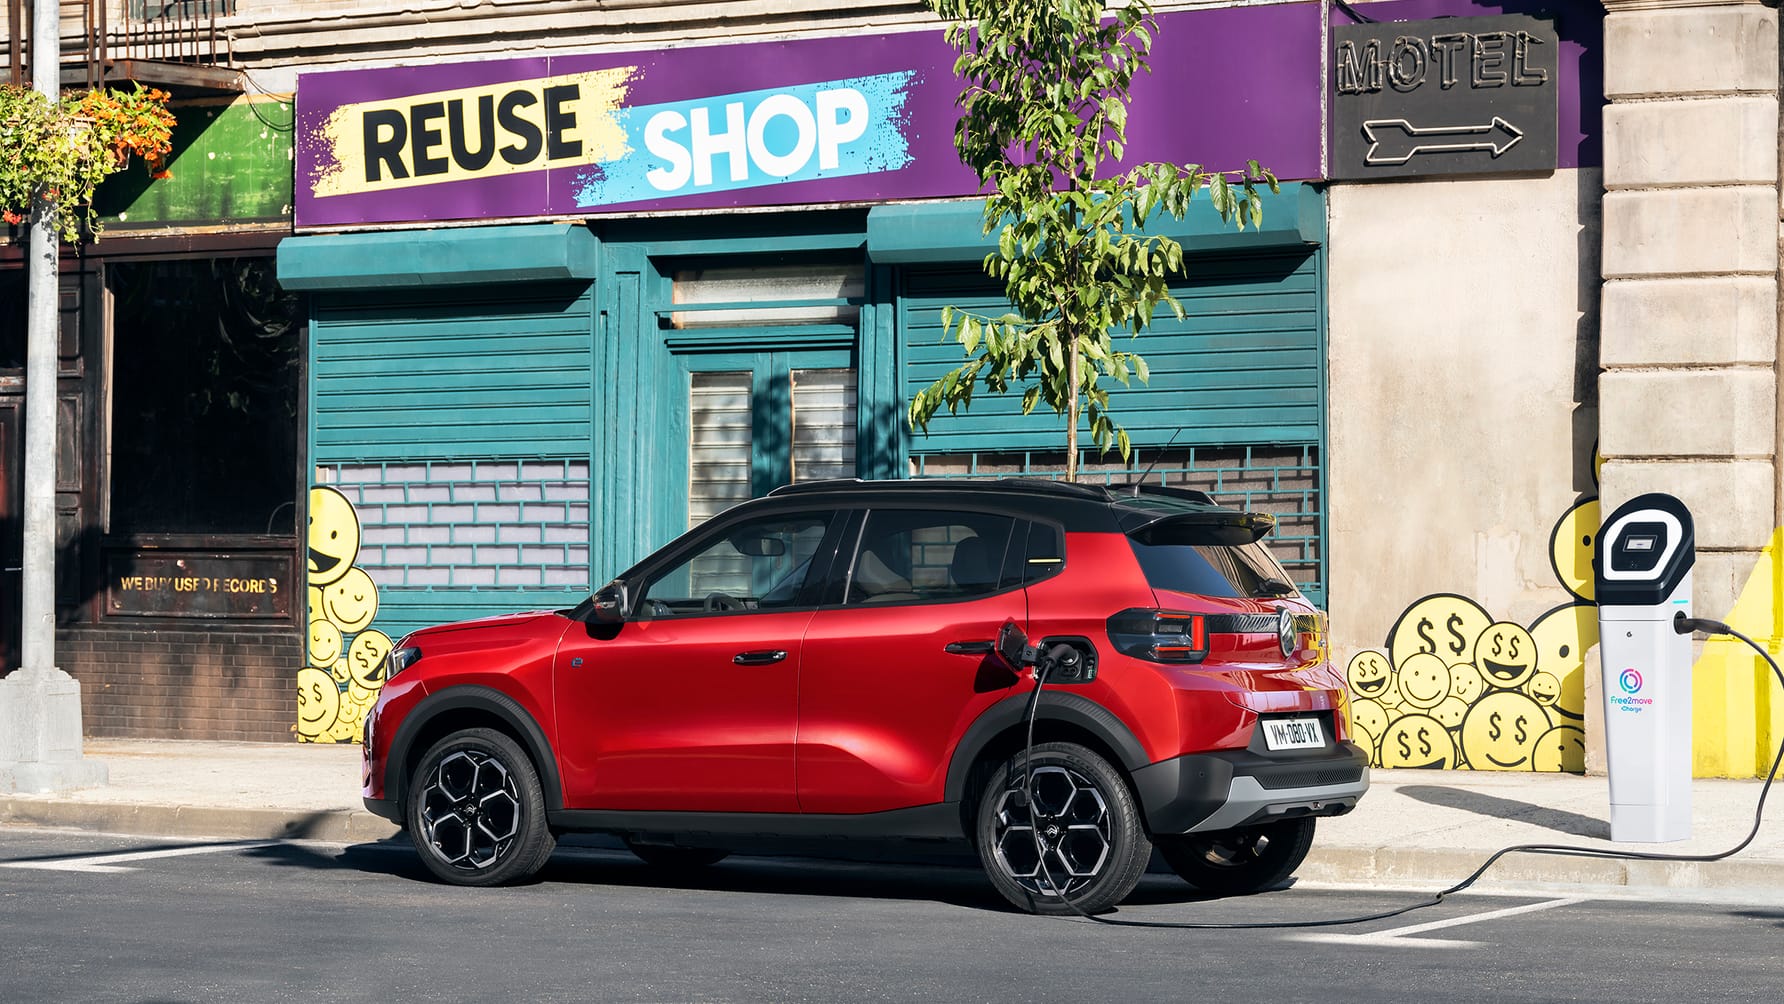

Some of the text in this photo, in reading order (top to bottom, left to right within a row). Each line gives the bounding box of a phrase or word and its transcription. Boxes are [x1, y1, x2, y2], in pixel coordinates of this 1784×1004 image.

[1336, 31, 1549, 94] MOTEL
[362, 83, 870, 192] REUSE SHOP
[121, 576, 143, 591] WE
[1610, 695, 1653, 705] Free2move
